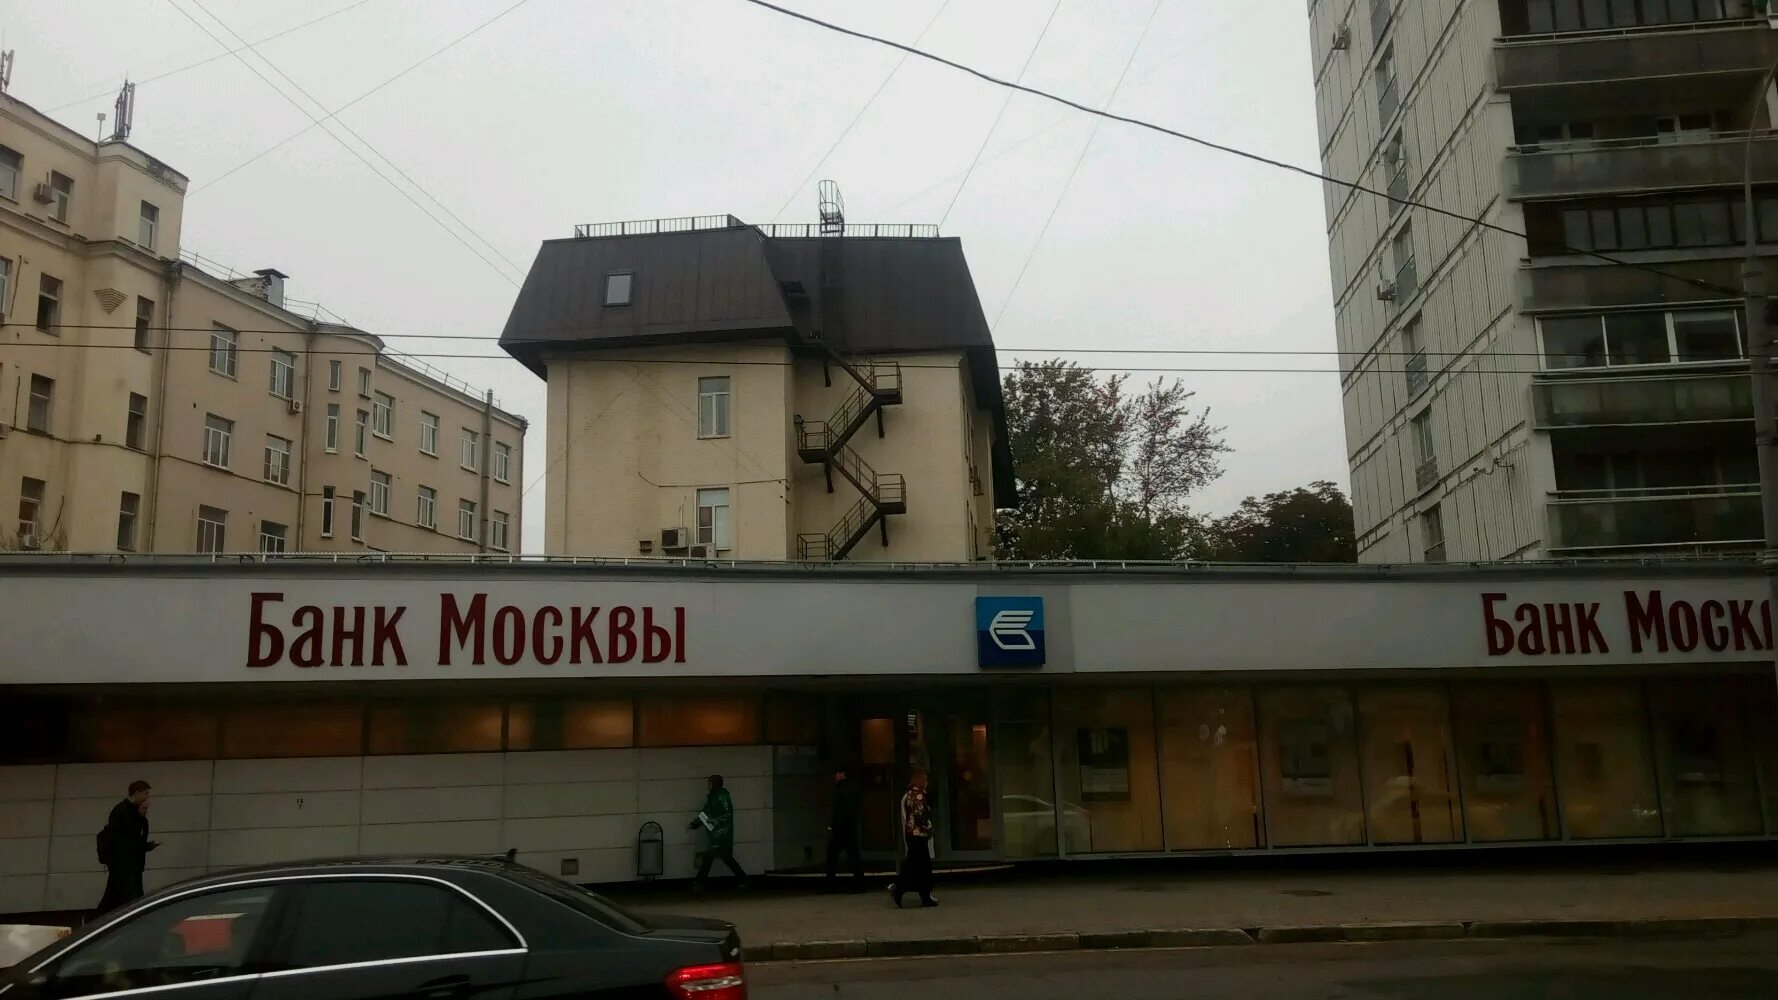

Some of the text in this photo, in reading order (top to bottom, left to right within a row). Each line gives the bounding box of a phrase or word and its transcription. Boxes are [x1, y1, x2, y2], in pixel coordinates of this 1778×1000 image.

[247, 593, 687, 667] Банк Москвы
[1481, 592, 1610, 656] Банк
